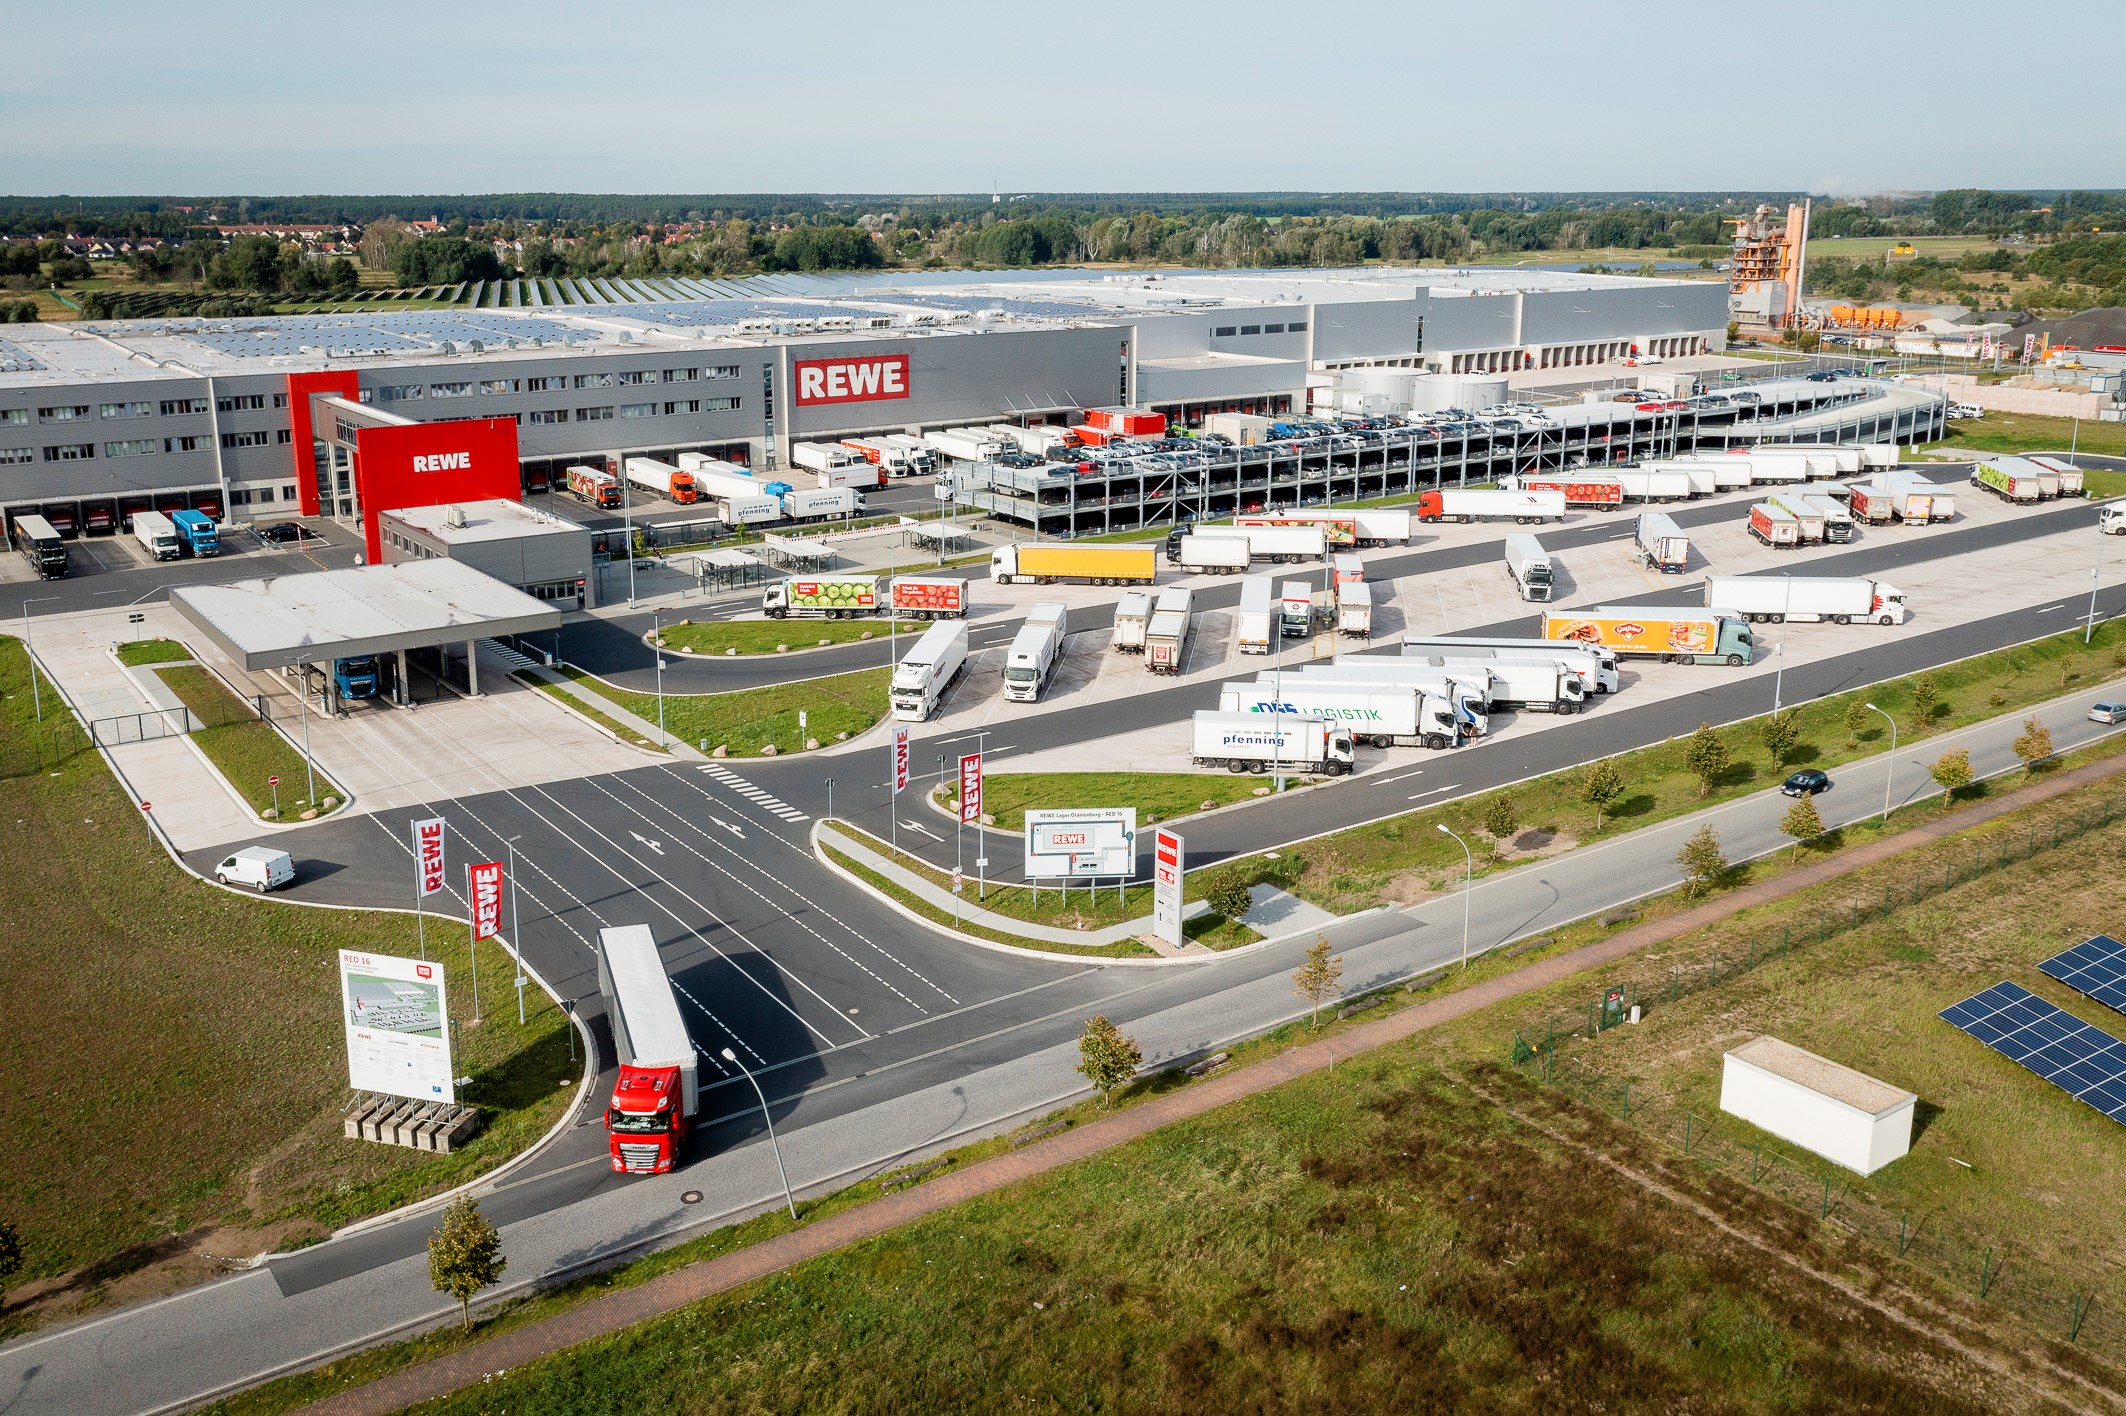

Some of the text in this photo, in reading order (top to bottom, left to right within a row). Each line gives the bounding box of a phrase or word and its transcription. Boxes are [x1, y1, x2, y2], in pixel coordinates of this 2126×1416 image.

[800, 361, 905, 399] REWE
[413, 451, 471, 473] REWE
[737, 508, 770, 516] pfenning
[808, 500, 839, 508] pfenning
[1616, 625, 1642, 634] Gutfried
[1223, 734, 1285, 747] pfenning
[897, 729, 908, 790] REWE
[964, 757, 980, 820] REWE
[1053, 834, 1085, 844] REWE
[421, 823, 443, 892] REWE
[1158, 842, 1177, 858] REWE
[475, 866, 498, 938] REWE
[343, 954, 371, 965] RED 16
